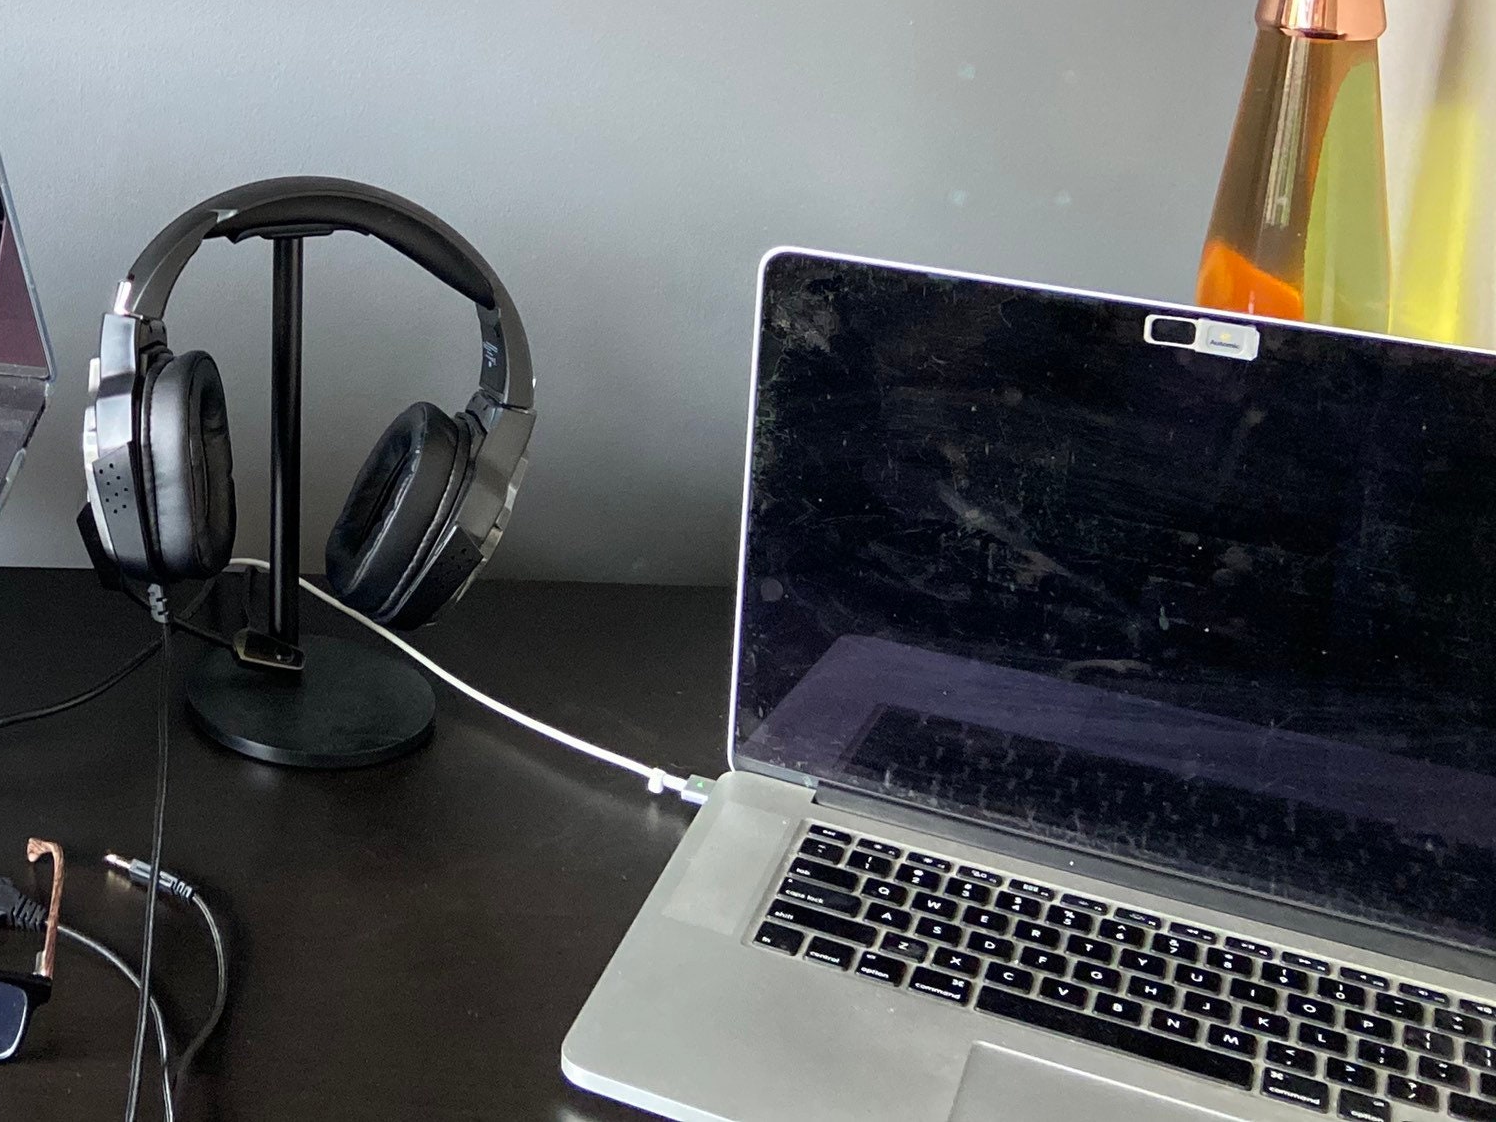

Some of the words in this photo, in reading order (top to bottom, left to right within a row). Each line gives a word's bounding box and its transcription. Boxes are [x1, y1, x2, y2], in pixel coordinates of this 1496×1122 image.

[774, 910, 794, 920] shift
[898, 942, 909, 951] Z
[950, 957, 961, 965] X
[1004, 972, 1014, 980] C
[1059, 987, 1068, 995] V
[1167, 1019, 1180, 1028] N
[1223, 1035, 1239, 1045] M
[879, 887, 890, 895] Q
[928, 900, 941, 909] W
[1138, 958, 1147, 966] Y
[1191, 973, 1203, 982] U
[1303, 1004, 1316, 1012] O
[1363, 1020, 1373, 1028] P
[985, 941, 995, 949] D
[1145, 986, 1157, 995] H
[1258, 1017, 1268, 1027] K
[1318, 1034, 1326, 1042] L
[809, 951, 840, 964] control
[860, 967, 890, 979] option
[914, 982, 961, 1000] command
[1268, 1086, 1321, 1106] command
